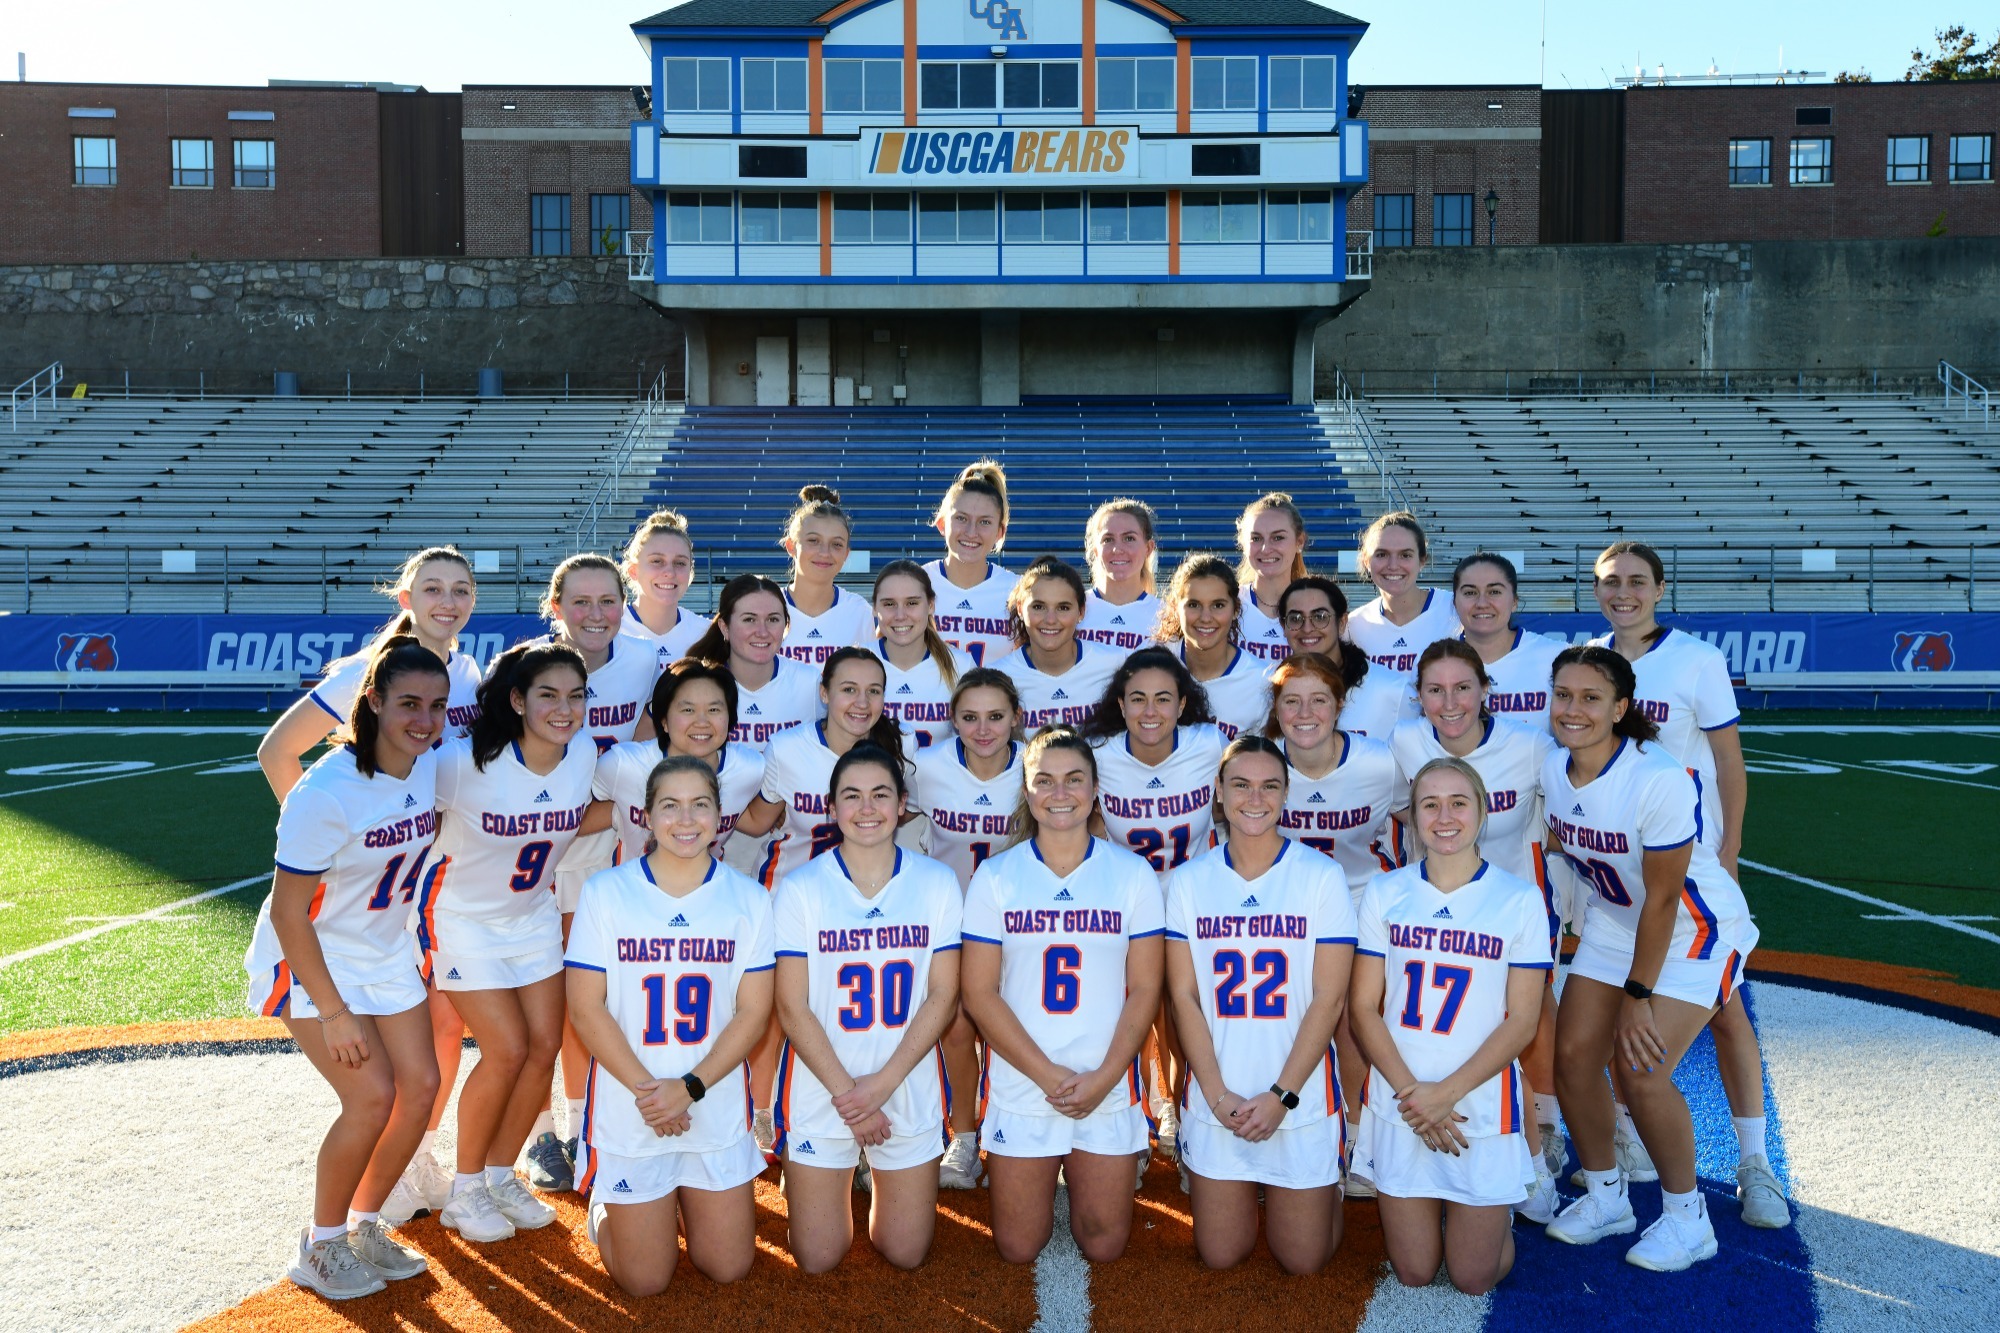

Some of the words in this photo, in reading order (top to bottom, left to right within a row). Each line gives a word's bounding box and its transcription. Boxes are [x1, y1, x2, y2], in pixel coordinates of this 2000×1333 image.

[934, 614, 962, 632] AST
[946, 640, 986, 668] 1
[1692, 631, 1807, 673] ARD
[588, 701, 637, 728] GUARD
[1488, 691, 1547, 712] GUARD
[1103, 793, 1154, 819] COAST
[1157, 784, 1211, 818] GUARD
[481, 811, 542, 837] COAST
[931, 808, 980, 834] COAST
[1276, 808, 1315, 830] AST
[1316, 805, 1371, 831] GUARD
[364, 818, 414, 848] COAST
[1126, 822, 1191, 872] 21
[1577, 826, 1630, 854] GUARD
[367, 843, 433, 911] 14
[509, 840, 554, 893] 9
[1004, 909, 1060, 934] COAST
[1063, 909, 1122, 935] GUARD
[1196, 915, 1246, 939] COAST
[1248, 914, 1307, 940] GUARD
[617, 938, 676, 963] COAST
[678, 937, 736, 963] GUARD
[818, 928, 873, 953] COAST
[876, 924, 929, 950] GUARD
[1439, 929, 1504, 961] GUARD
[1041, 943, 1083, 1015] 6
[1212, 948, 1289, 1019] 22
[641, 972, 712, 1046] 19
[836, 958, 915, 1033] 30
[1400, 959, 1474, 1036] 17
